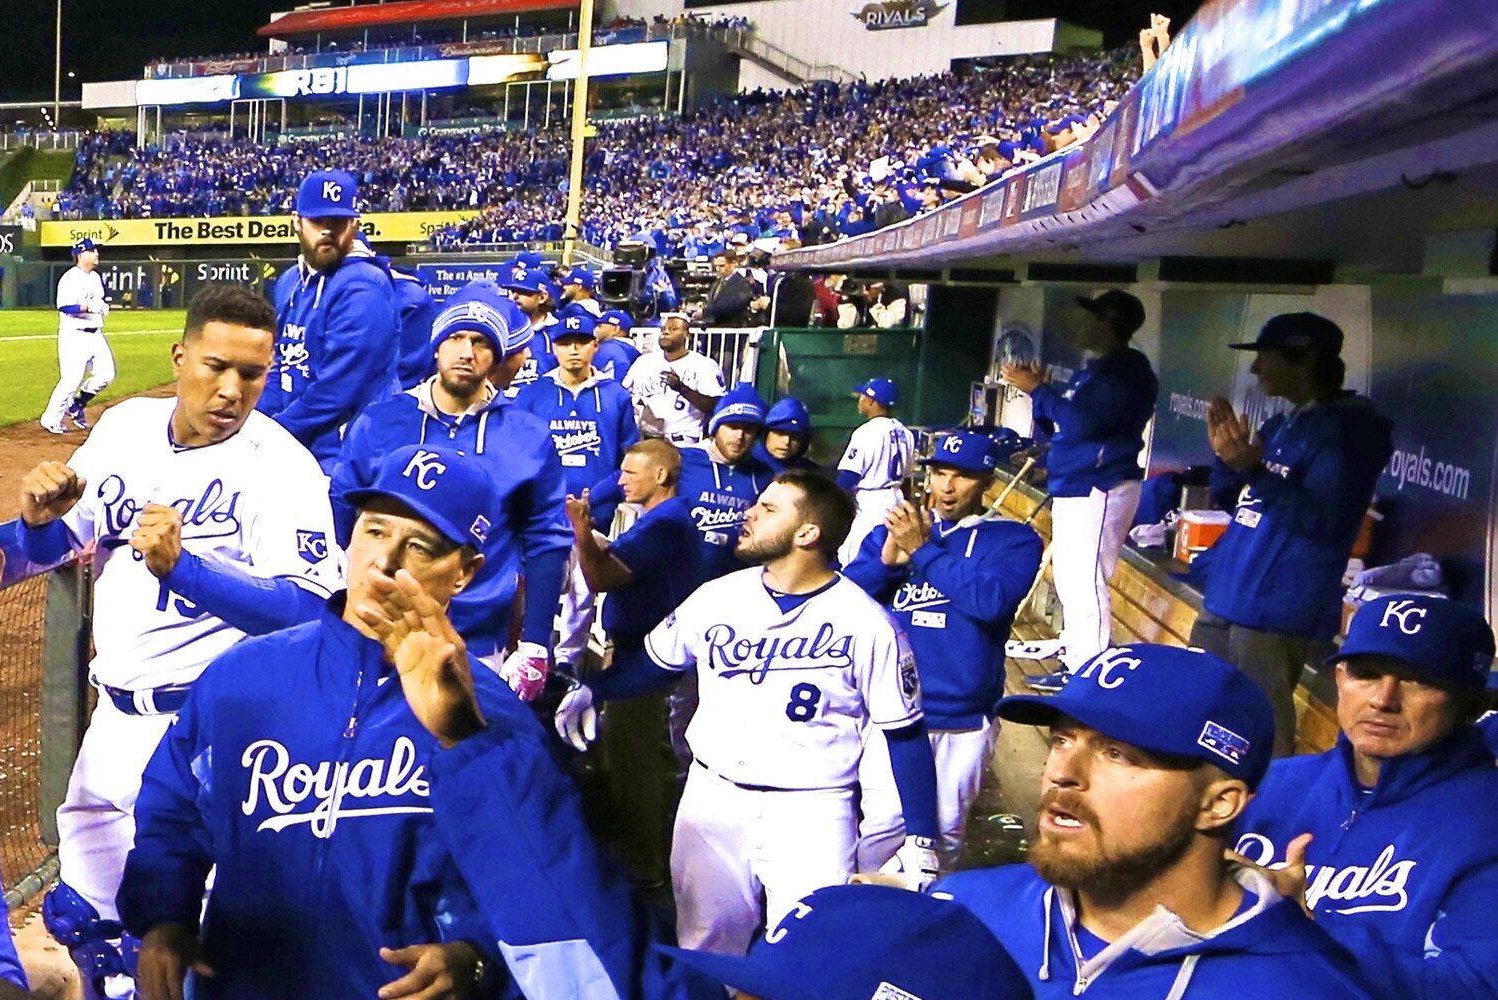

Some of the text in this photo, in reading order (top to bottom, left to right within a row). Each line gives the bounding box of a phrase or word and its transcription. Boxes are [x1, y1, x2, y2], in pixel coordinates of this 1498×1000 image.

[866, 8, 926, 25] RIVALS
[323, 181, 342, 201] KC
[70, 229, 102, 241] Sprint
[155, 222, 193, 239] The
[197, 221, 244, 239] Best
[102, 265, 146, 291] rint
[436, 270, 454, 280] The
[675, 394, 685, 411] 6
[550, 420, 597, 431] ALWAYS
[943, 436, 963, 453] KC
[402, 449, 447, 490] KC
[1390, 445, 1470, 499] oyals.com
[98, 474, 240, 561] Roals
[298, 532, 328, 557] KC
[1380, 600, 1427, 635] KC
[704, 622, 852, 685] Royals
[1082, 646, 1142, 690] KC
[785, 682, 821, 722] 8
